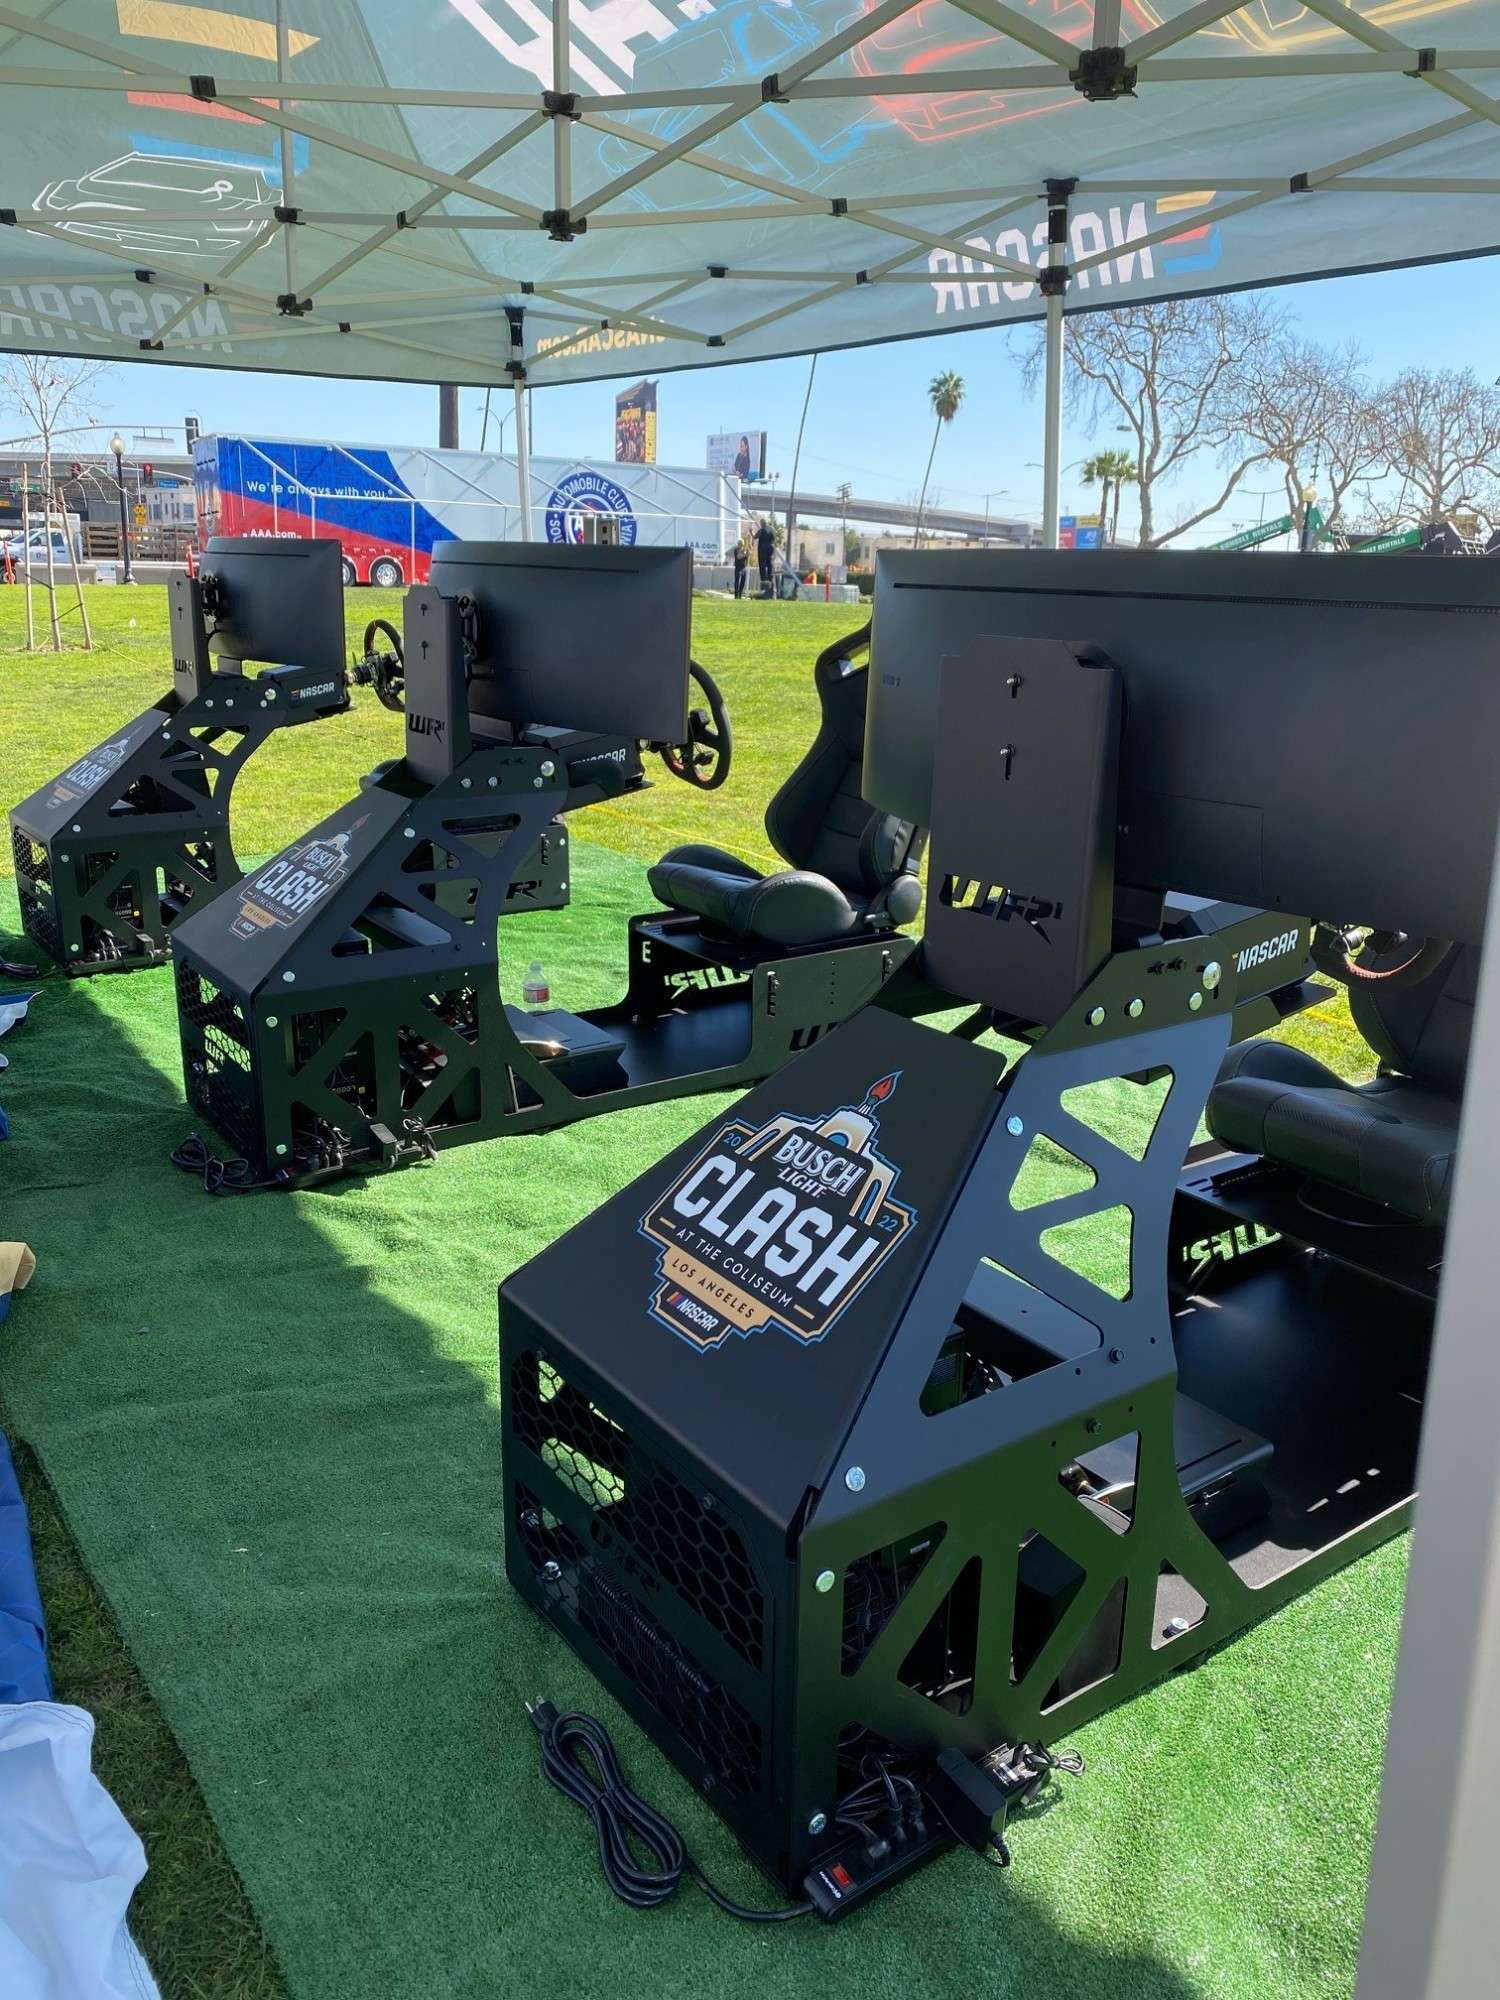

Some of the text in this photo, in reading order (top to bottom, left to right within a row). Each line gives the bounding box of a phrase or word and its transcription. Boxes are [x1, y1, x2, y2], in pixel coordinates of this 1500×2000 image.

[247, 481, 283, 493] We're
[335, 486, 359, 497] with
[250, 528, 296, 539] AAA.com
[299, 682, 335, 698] NASCAR
[255, 860, 330, 913] CLASH
[1237, 929, 1299, 973] NASCAR
[723, 1133, 742, 1148] 20
[772, 1134, 867, 1197] BUSCH
[673, 1154, 880, 1307] CLASH
[876, 1215, 898, 1232] 22
[676, 1227, 793, 1308] AT THE COLISEUM
[671, 1258, 755, 1320] LOS ANGELES
[677, 1297, 720, 1331] NASCAR
